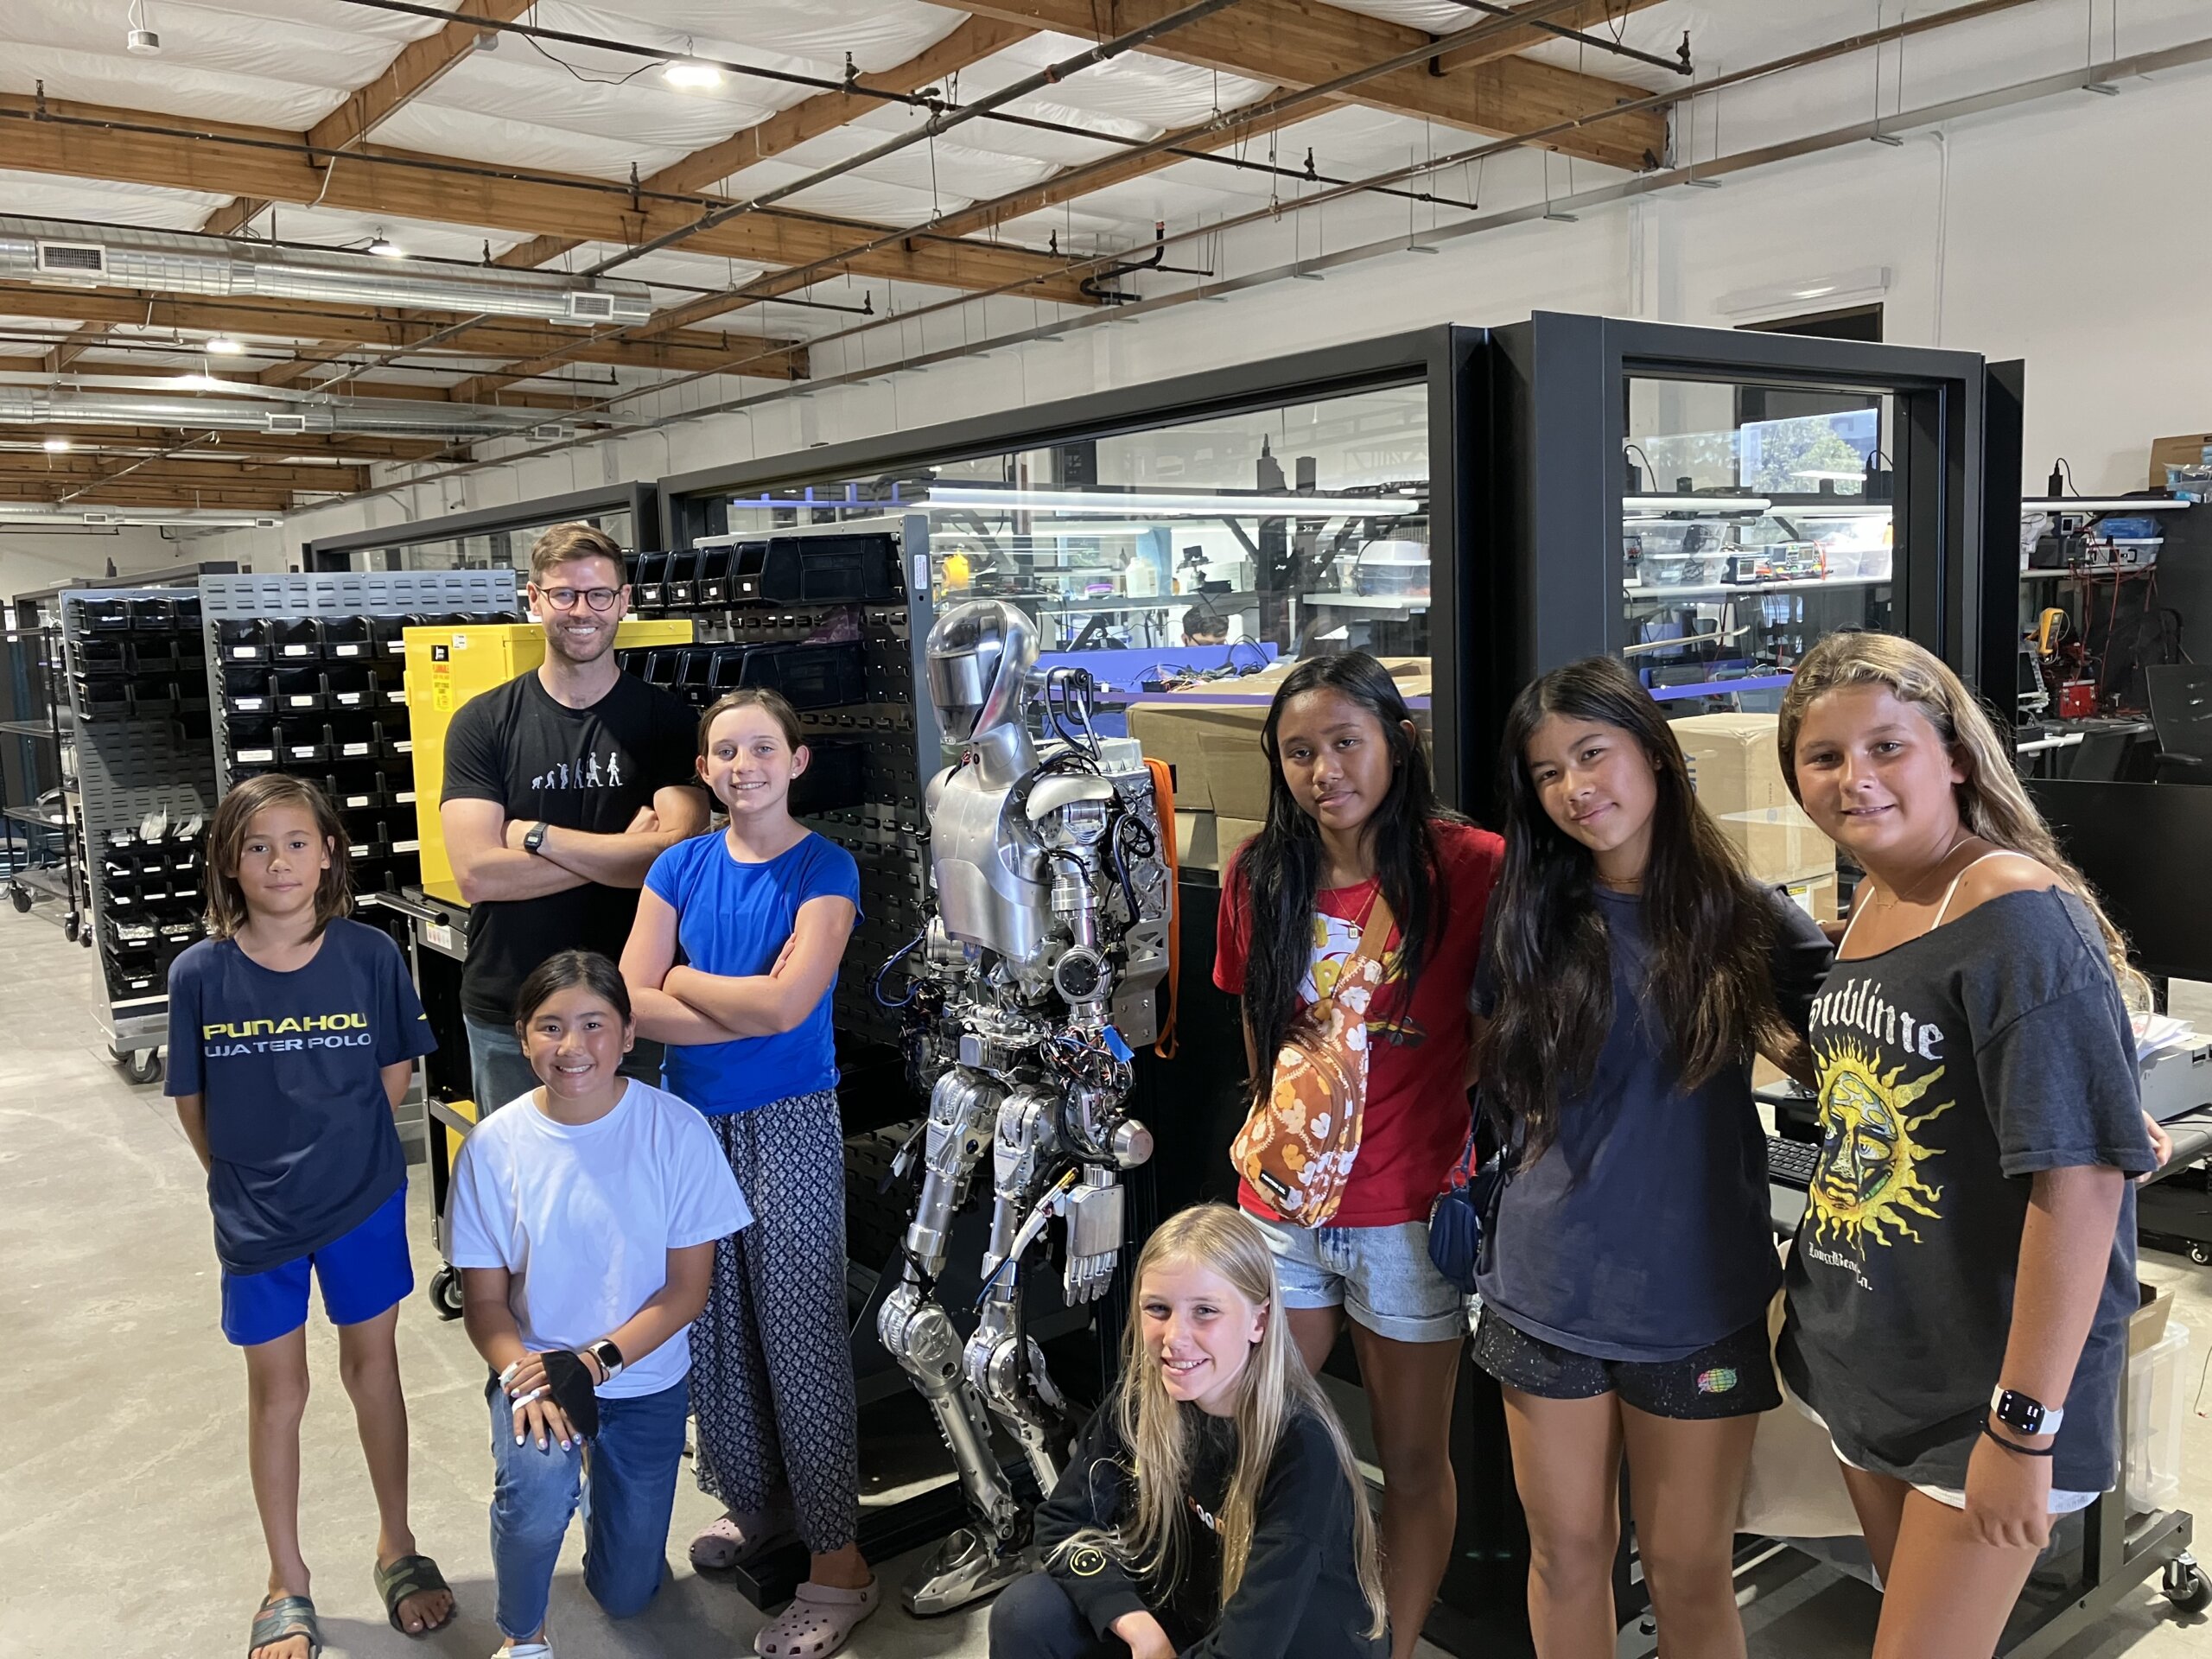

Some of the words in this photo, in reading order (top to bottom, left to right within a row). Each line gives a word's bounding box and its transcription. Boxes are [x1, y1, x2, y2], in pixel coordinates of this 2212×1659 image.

[202, 1013, 367, 1040] PUNAHOU
[205, 1039, 302, 1058] WATER
[308, 1033, 372, 1049] POLO
